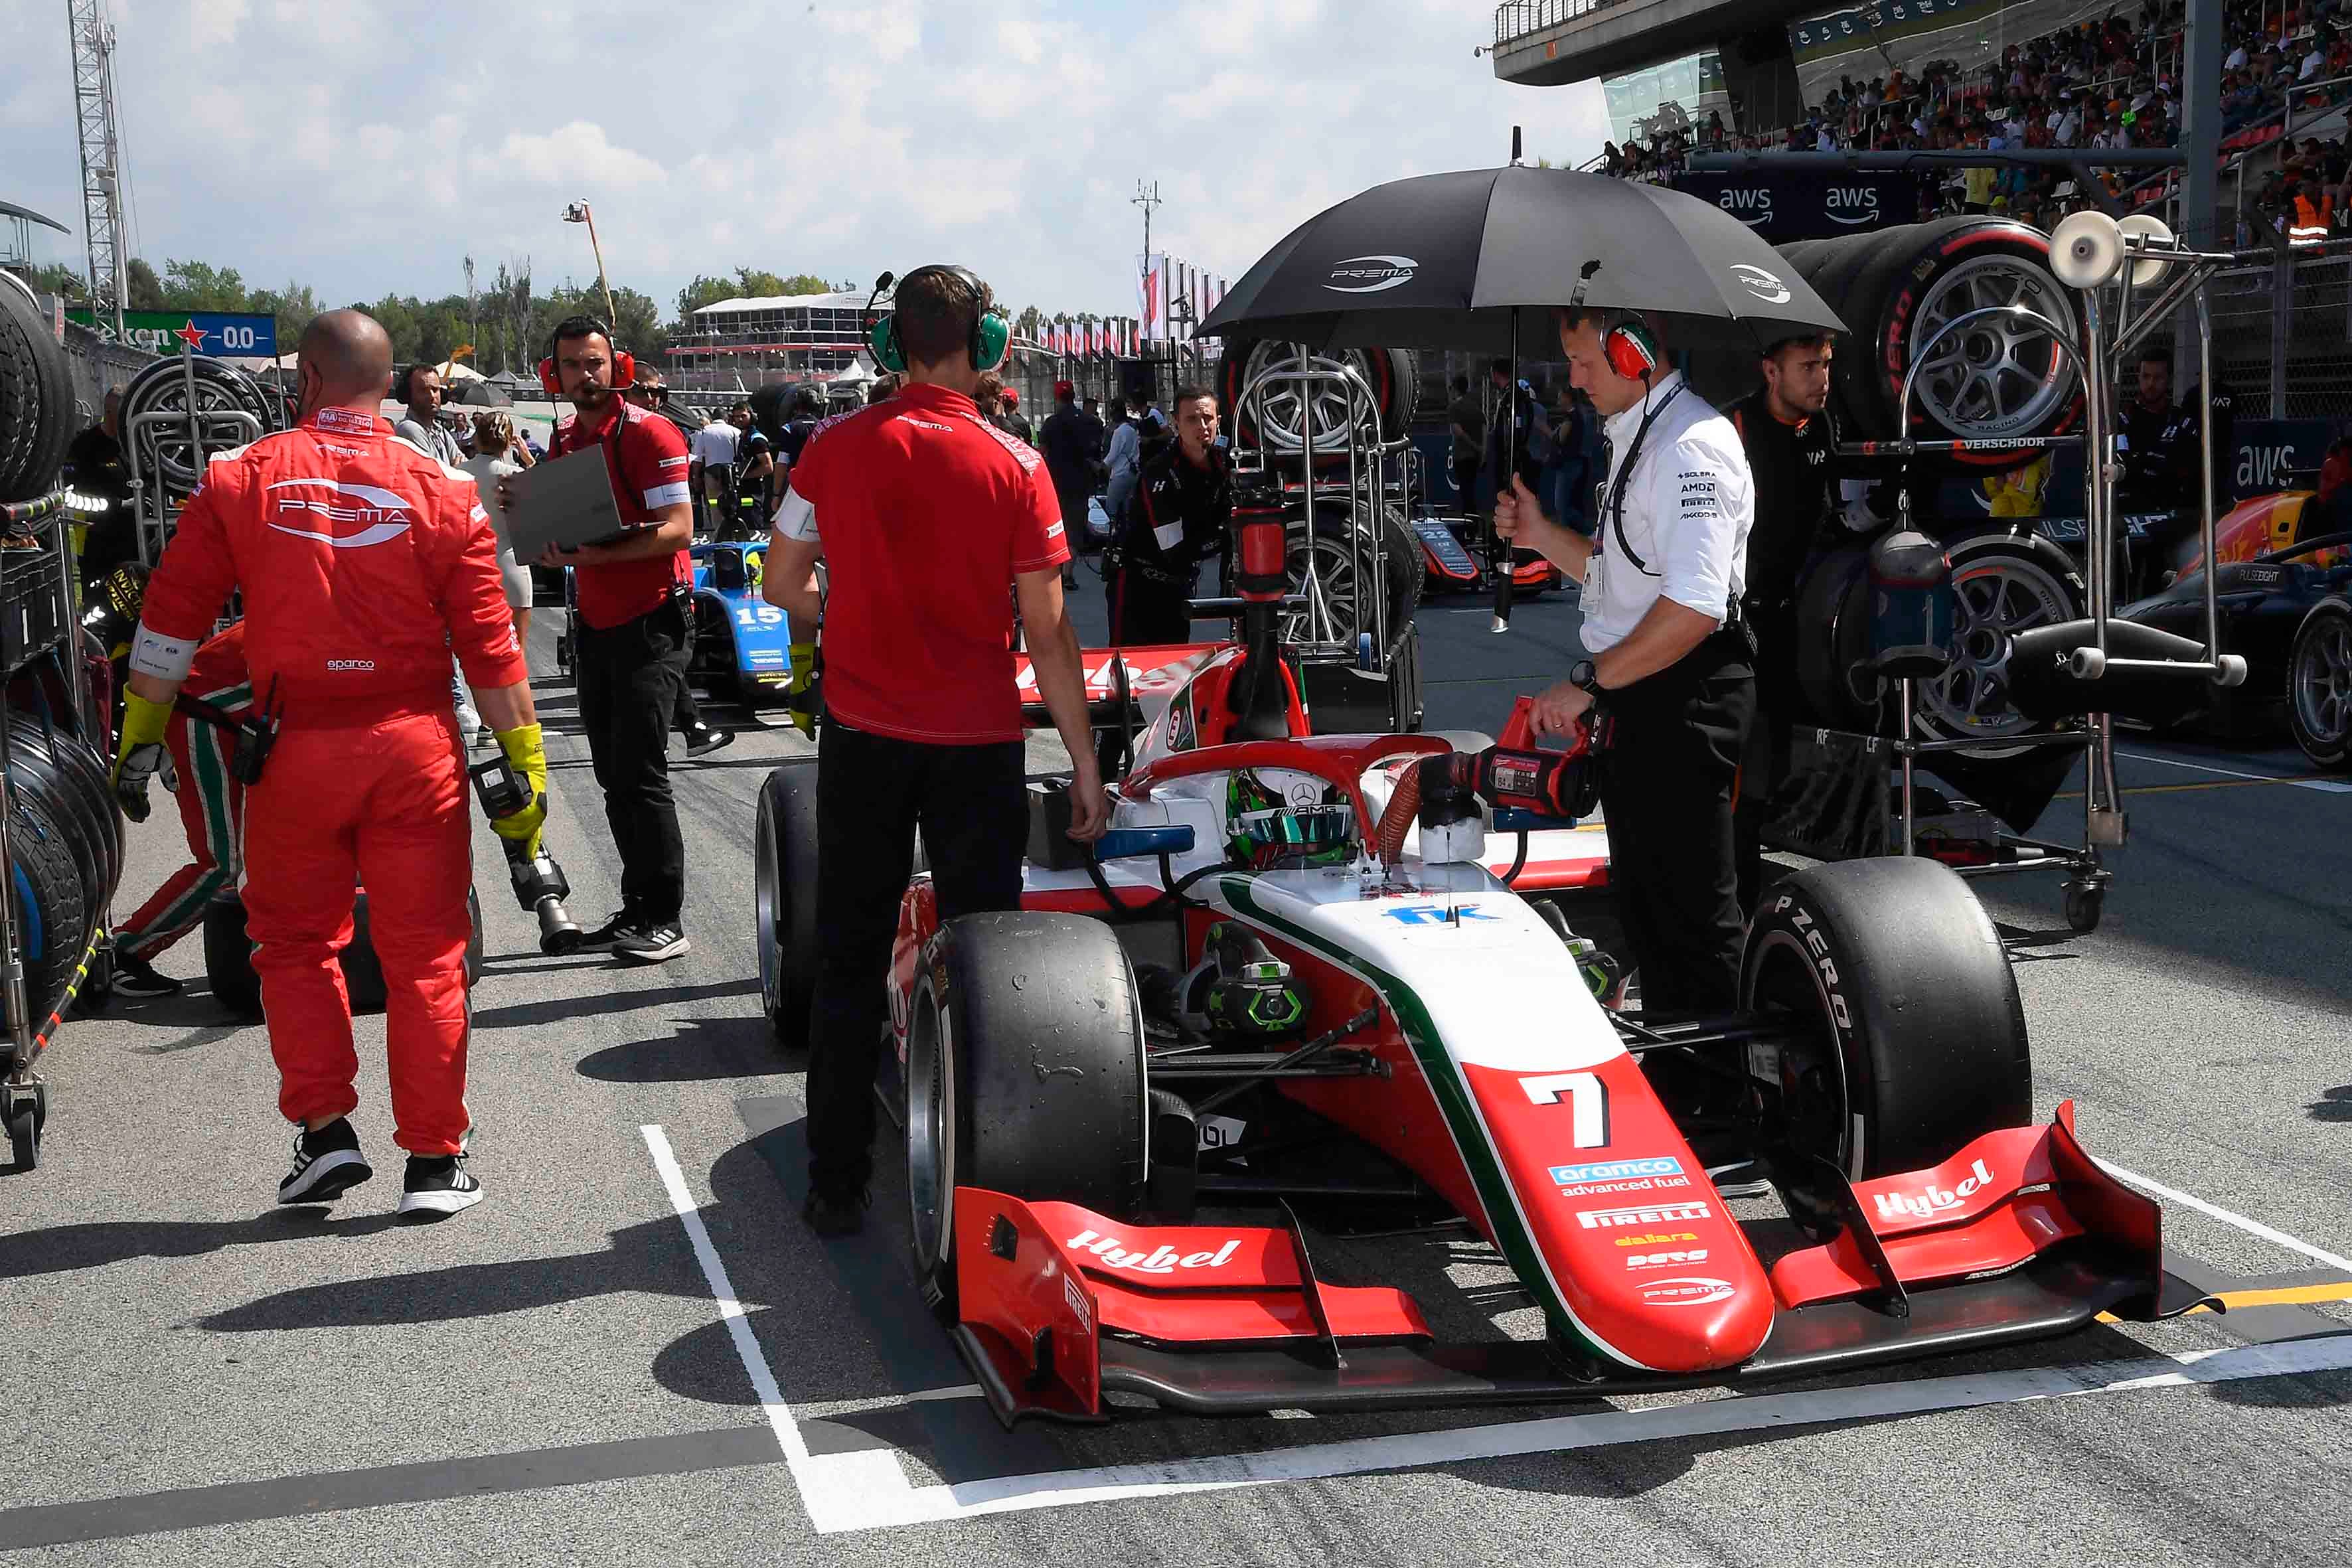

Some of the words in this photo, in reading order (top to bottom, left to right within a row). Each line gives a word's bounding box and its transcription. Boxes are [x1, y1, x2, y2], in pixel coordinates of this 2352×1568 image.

[1720, 189, 1771, 208] aws
[1826, 187, 1877, 207] aws
[1330, 268, 1413, 278] PREMA
[1739, 275, 1788, 290] PREMA
[223, 327, 254, 349] 0.0
[896, 415, 953, 432] PREMA
[1964, 438, 2045, 449] VERSCHOOR
[2236, 445, 2295, 487] aws
[1681, 483, 1706, 493] AMD
[278, 499, 411, 522] PREMA
[1423, 531, 1451, 540] 22
[736, 607, 783, 625] 15
[327, 659, 374, 670] sparco
[1294, 805, 1337, 815] AMG
[1774, 895, 1792, 913] P
[1792, 907, 1852, 1028] ZERO
[1517, 1071, 1611, 1149] 7
[1557, 1159, 1675, 1181] aramco
[1561, 1178, 1654, 1197] advanced
[1656, 1175, 1692, 1189] fuel
[1873, 1158, 1995, 1218] Hybel
[1575, 1201, 1712, 1229] PIRELLI
[1614, 1232, 1699, 1247] dallara
[1066, 1229, 1242, 1274] Hybel
[1643, 1285, 1735, 1298] PREMA
[1063, 1271, 1091, 1336] PIRELLI
